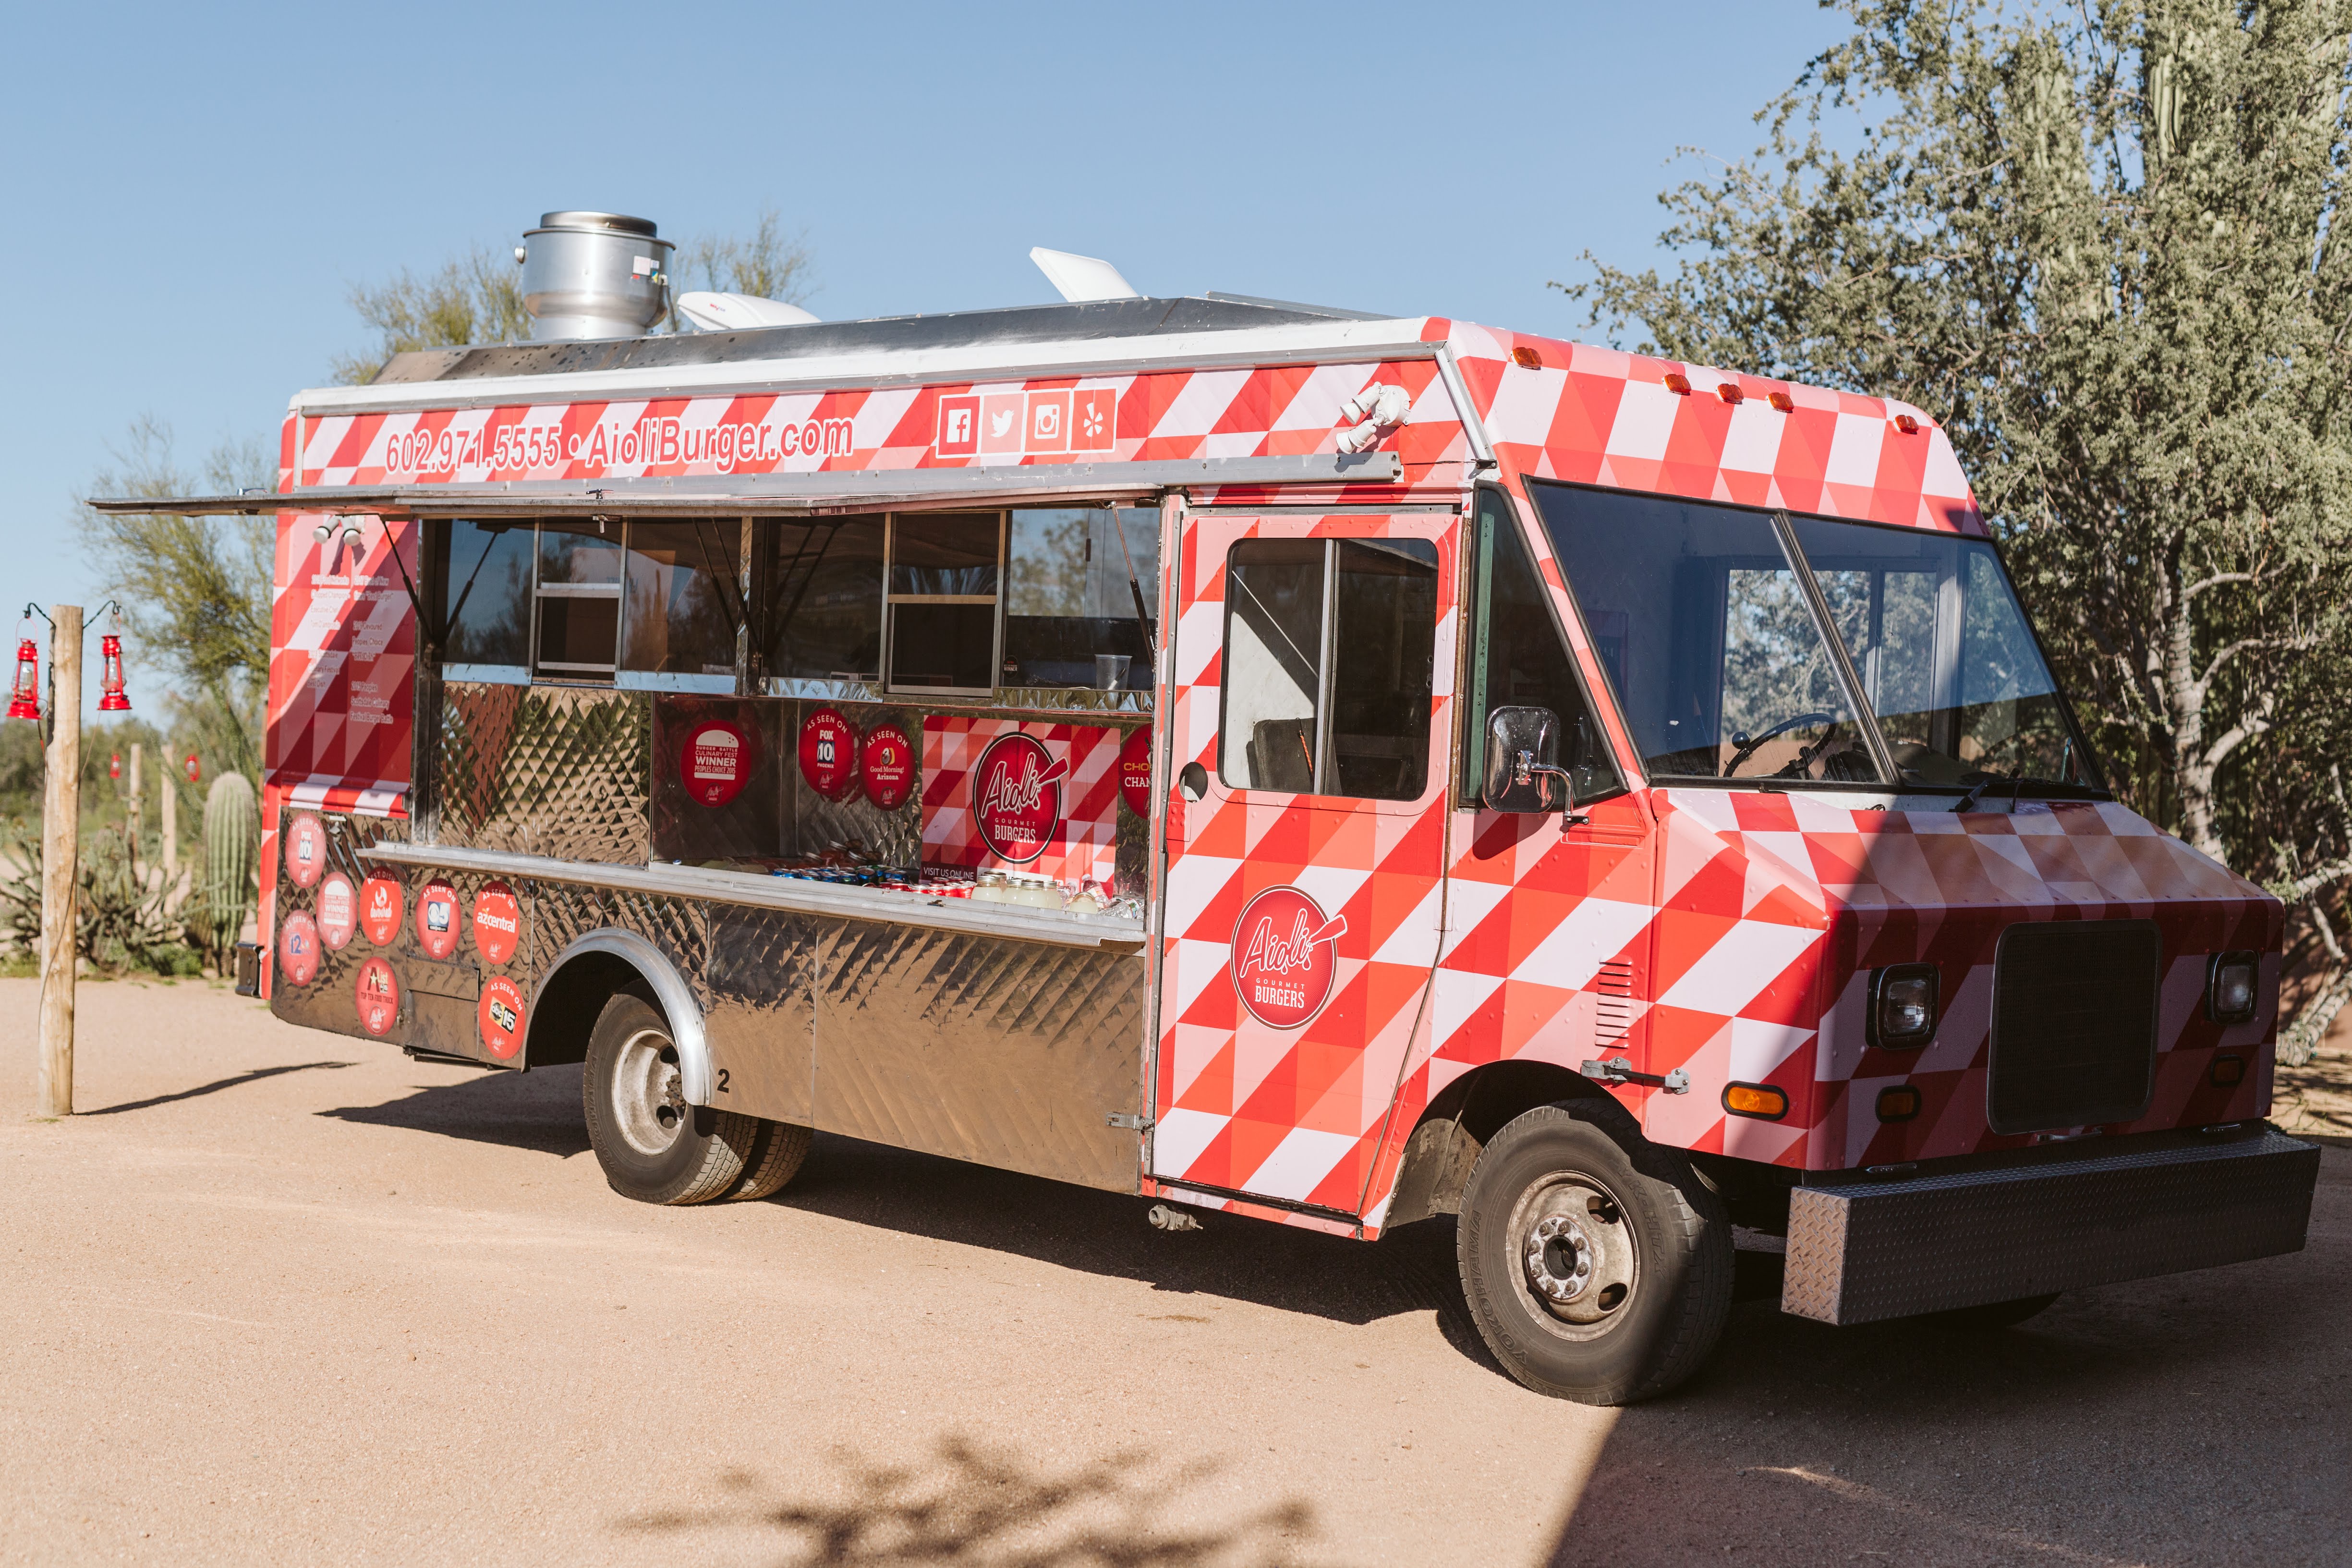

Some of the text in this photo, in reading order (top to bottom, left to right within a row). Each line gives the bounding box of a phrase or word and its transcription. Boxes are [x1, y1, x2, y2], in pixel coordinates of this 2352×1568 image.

[386, 416, 855, 475] 602.971.5555 AioliBurger.com
[807, 715, 848, 733] AS SEEN ON
[819, 729, 834, 740] FOX
[867, 730, 908, 748] AS SEEN ON
[818, 743, 833, 761] 10
[696, 756, 737, 767] WINNER
[981, 752, 1041, 818] Aioli
[292, 822, 299, 831] AS
[314, 823, 322, 835] ON
[995, 818, 1036, 827] GOURMET
[994, 825, 1036, 844] BURGERS
[300, 841, 310, 859] 10
[382, 871, 395, 884] DISH
[923, 867, 974, 880] VISIT US ONLINE
[423, 885, 456, 903] AS SEEN ON
[483, 888, 514, 910] AS SEEN IN
[325, 904, 349, 913] WINNER
[285, 920, 292, 930] AS
[307, 920, 315, 932] ON
[477, 911, 516, 933] azcentral
[291, 935, 301, 954] 12
[1240, 908, 1312, 978] Aioli
[1256, 978, 1305, 989] GOURMET
[383, 996, 393, 1004] TRUCK
[491, 983, 522, 1011] AS SEEN ON
[1255, 985, 1305, 1009] BURGERS
[502, 1009, 515, 1031] 15
[717, 1069, 730, 1094] 2
[1468, 1209, 1529, 1365] YOKOHAMA
